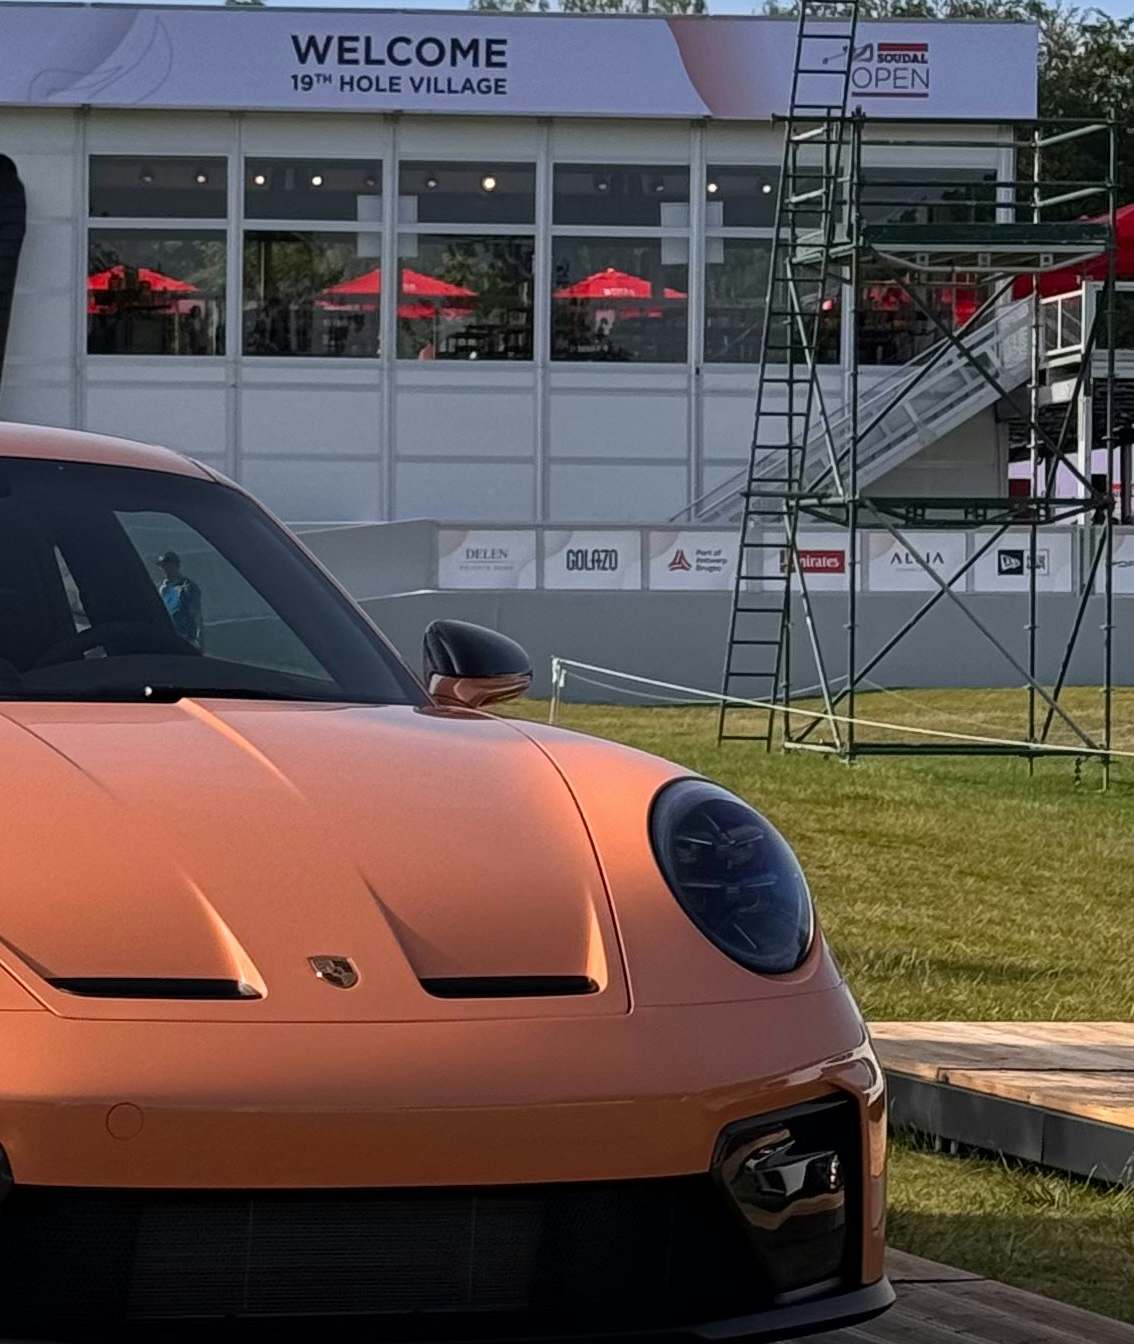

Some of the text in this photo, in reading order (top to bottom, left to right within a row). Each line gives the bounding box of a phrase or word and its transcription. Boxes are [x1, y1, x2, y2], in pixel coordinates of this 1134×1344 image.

[290, 34, 508, 68] WELCOME
[877, 52, 929, 64] SOUDAL
[290, 72, 508, 96] 19TH HOLE VILLAGE
[851, 66, 930, 89] OPEN
[466, 548, 509, 560] DELEN
[566, 548, 619, 572] GOLAZO
